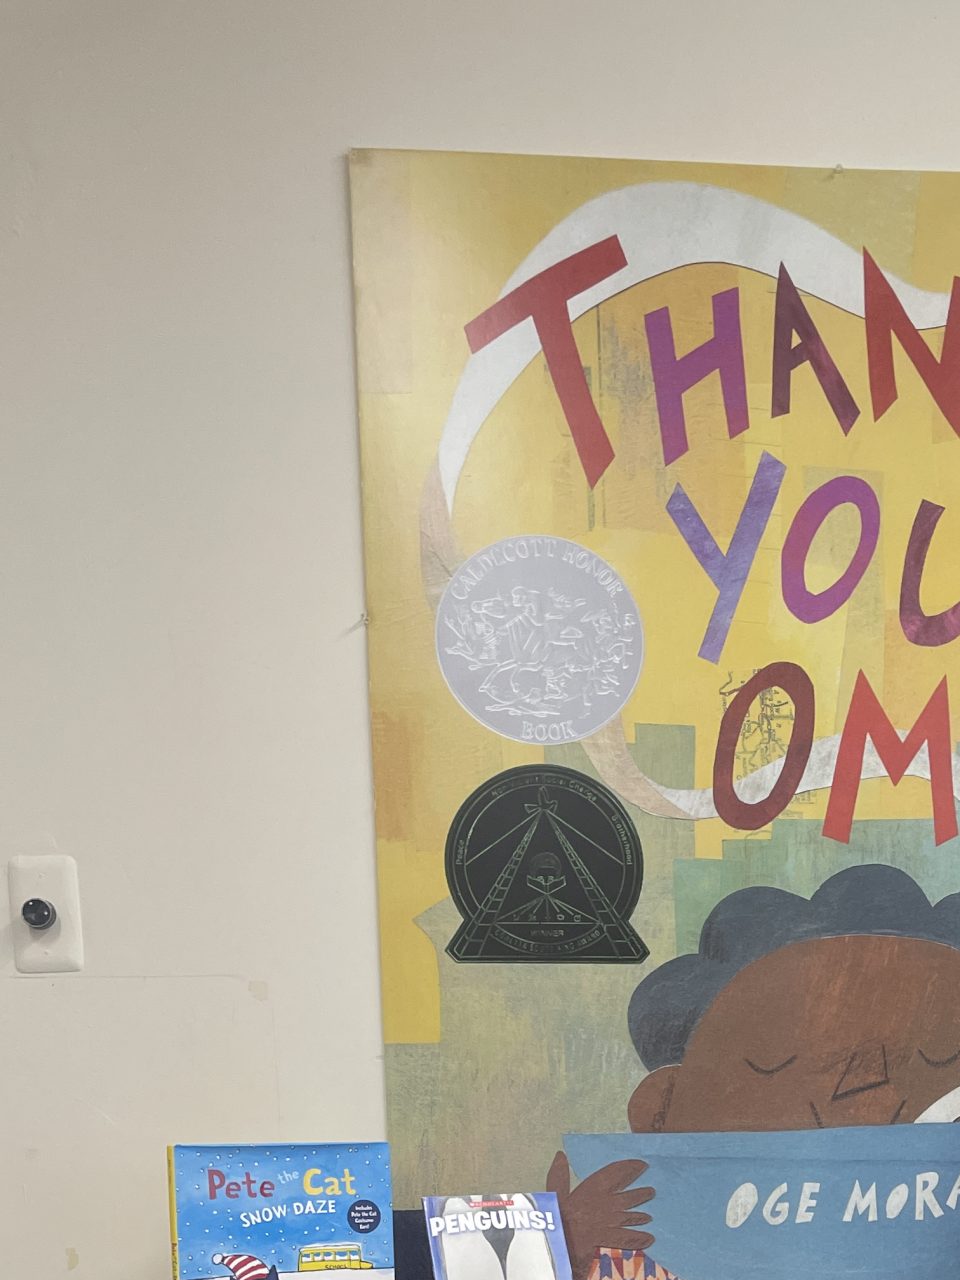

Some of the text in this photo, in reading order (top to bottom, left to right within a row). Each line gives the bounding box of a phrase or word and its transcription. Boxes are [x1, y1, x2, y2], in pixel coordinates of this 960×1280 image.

[451, 539, 623, 600] CALDECOTT HONOR
[521, 721, 577, 741] BOOK
[208, 1168, 356, 1200] Pete the Cat
[240, 1200, 336, 1227] SNOW DAZE
[725, 1181, 820, 1228] OGE
[429, 1211, 555, 1236] PENGUINS!
